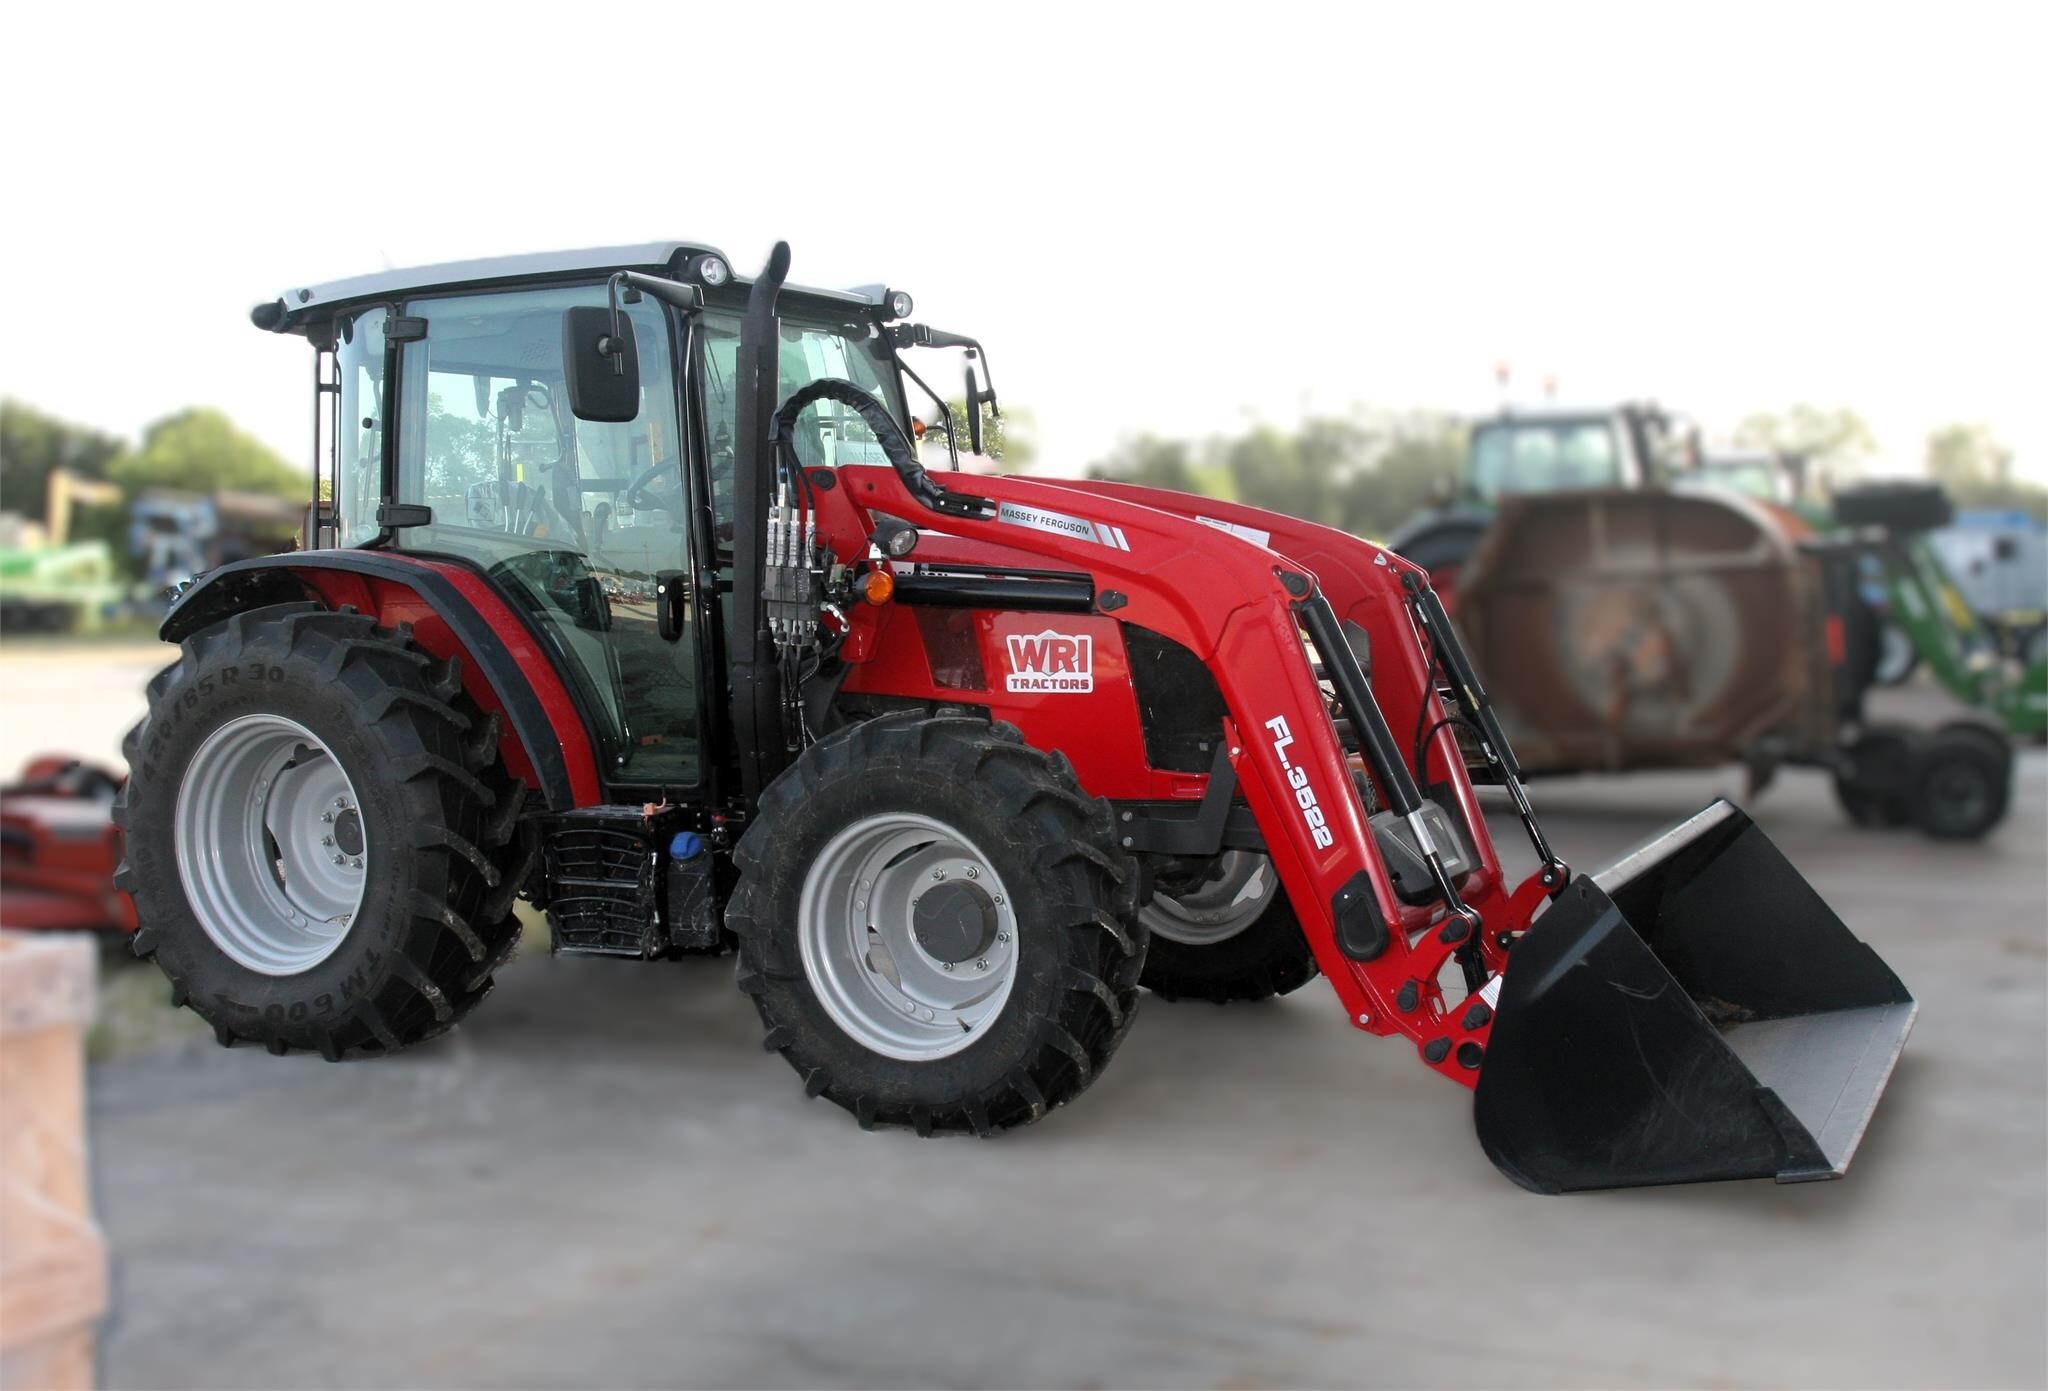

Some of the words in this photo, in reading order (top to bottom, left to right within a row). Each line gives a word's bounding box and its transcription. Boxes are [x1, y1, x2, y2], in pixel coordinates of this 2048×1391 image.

[1000, 508, 1038, 522] MASSEY
[1040, 516, 1090, 535] FERGUSON
[1009, 639, 1088, 673] WRI
[221, 665, 241, 686] R
[248, 663, 285, 683] 30
[1011, 679, 1090, 690] TRACTORS
[1264, 714, 1334, 851] FL.3522
